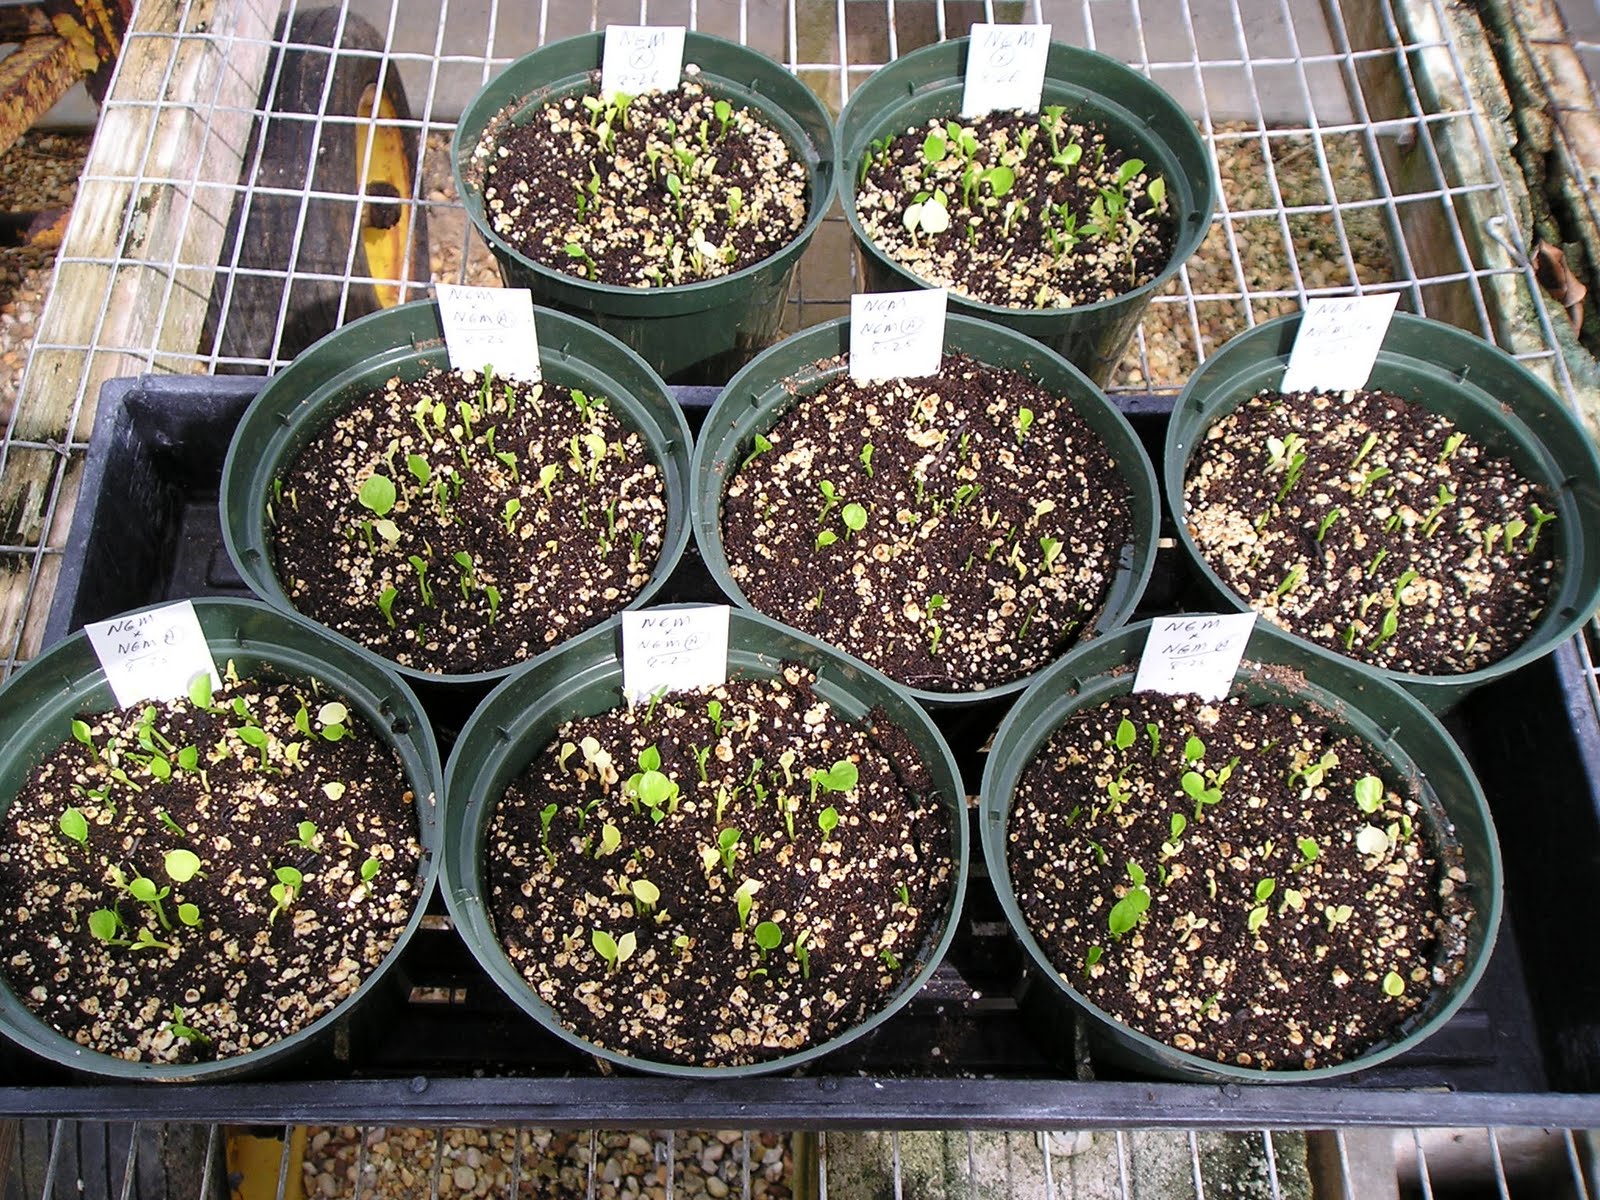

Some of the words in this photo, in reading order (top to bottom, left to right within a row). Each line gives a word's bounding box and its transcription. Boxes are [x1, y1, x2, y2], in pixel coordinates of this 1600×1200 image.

[107, 614, 154, 636] NGM
[1163, 619, 1220, 632] NGM
[118, 640, 157, 654] NGM
[1162, 642, 1208, 654] NGM
